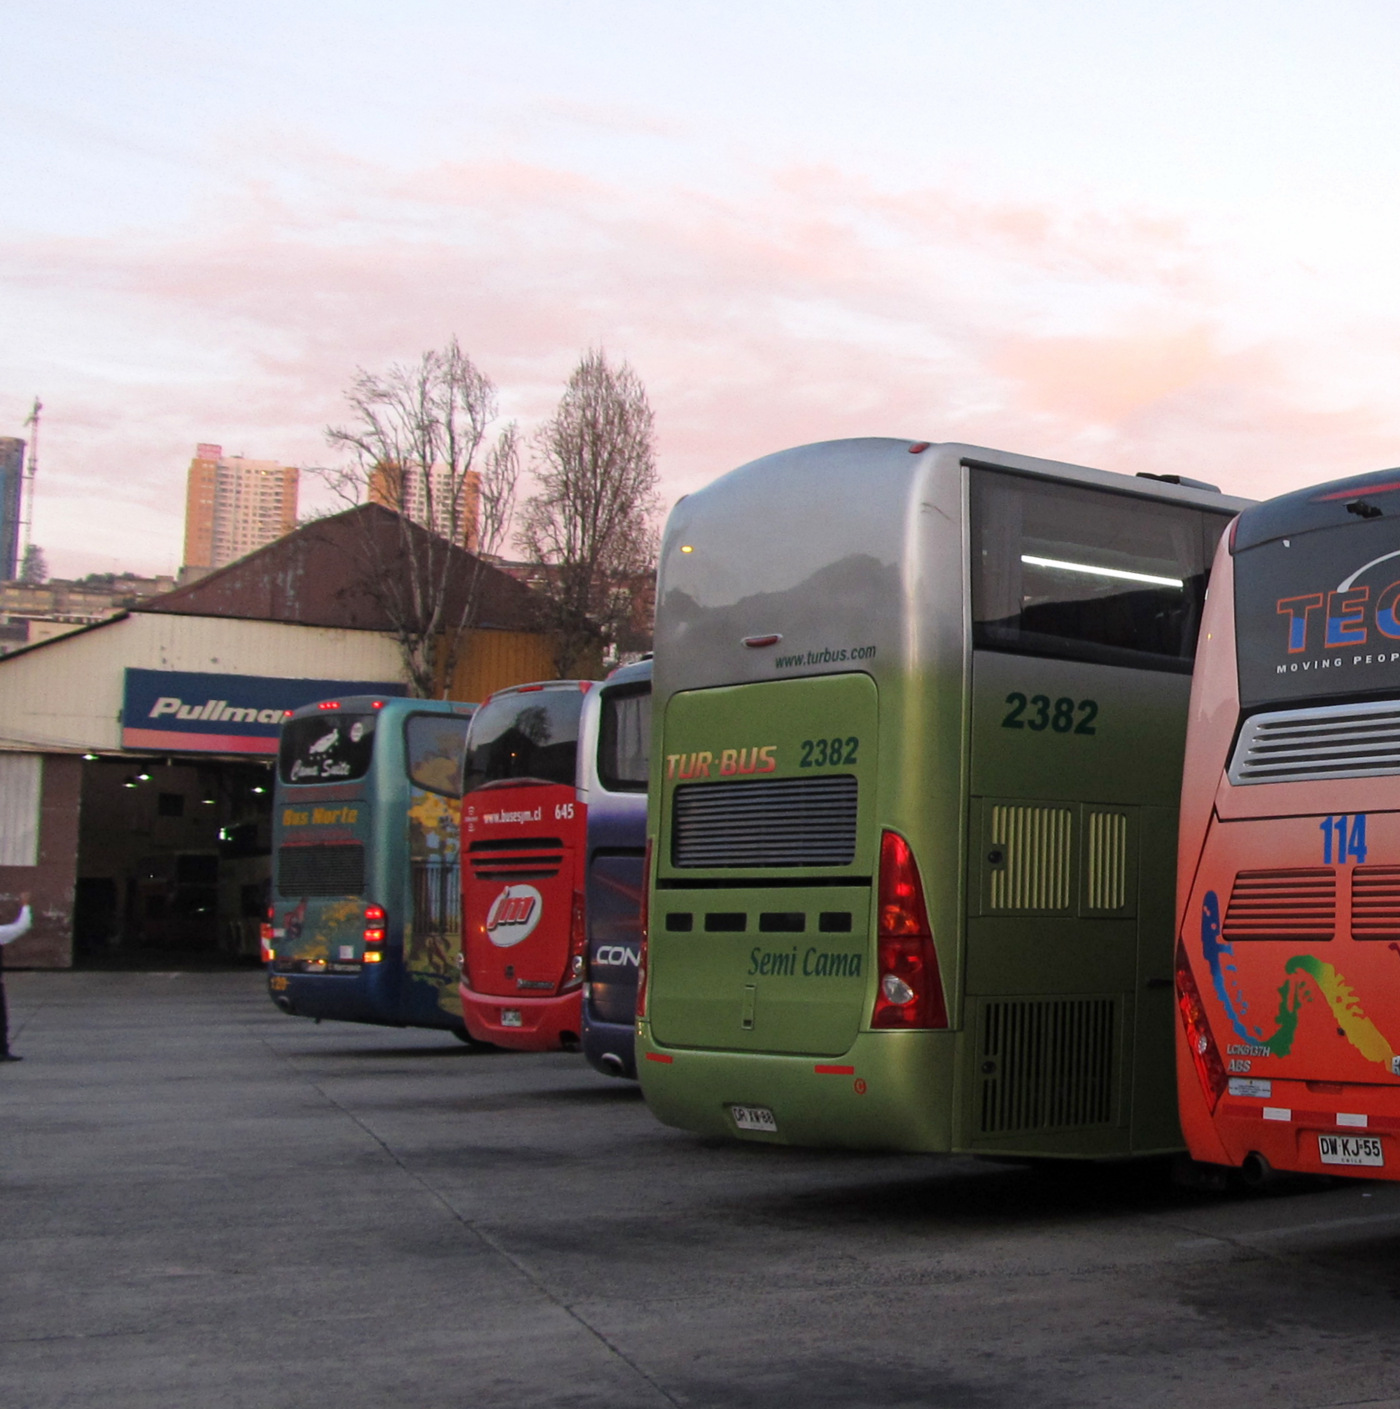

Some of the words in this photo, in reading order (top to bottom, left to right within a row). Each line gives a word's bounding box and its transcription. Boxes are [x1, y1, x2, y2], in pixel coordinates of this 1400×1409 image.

[776, 646, 876, 667] www.turbus.com
[1276, 658, 1342, 673] MOVING
[148, 697, 287, 724] Pullma
[1001, 692, 1098, 735] 2382
[800, 737, 859, 767] 2382
[554, 803, 574, 819] 645
[1319, 814, 1368, 865] 114
[747, 945, 798, 976] Semi
[801, 947, 863, 977] Cama
[1228, 1059, 1251, 1073] ABS
